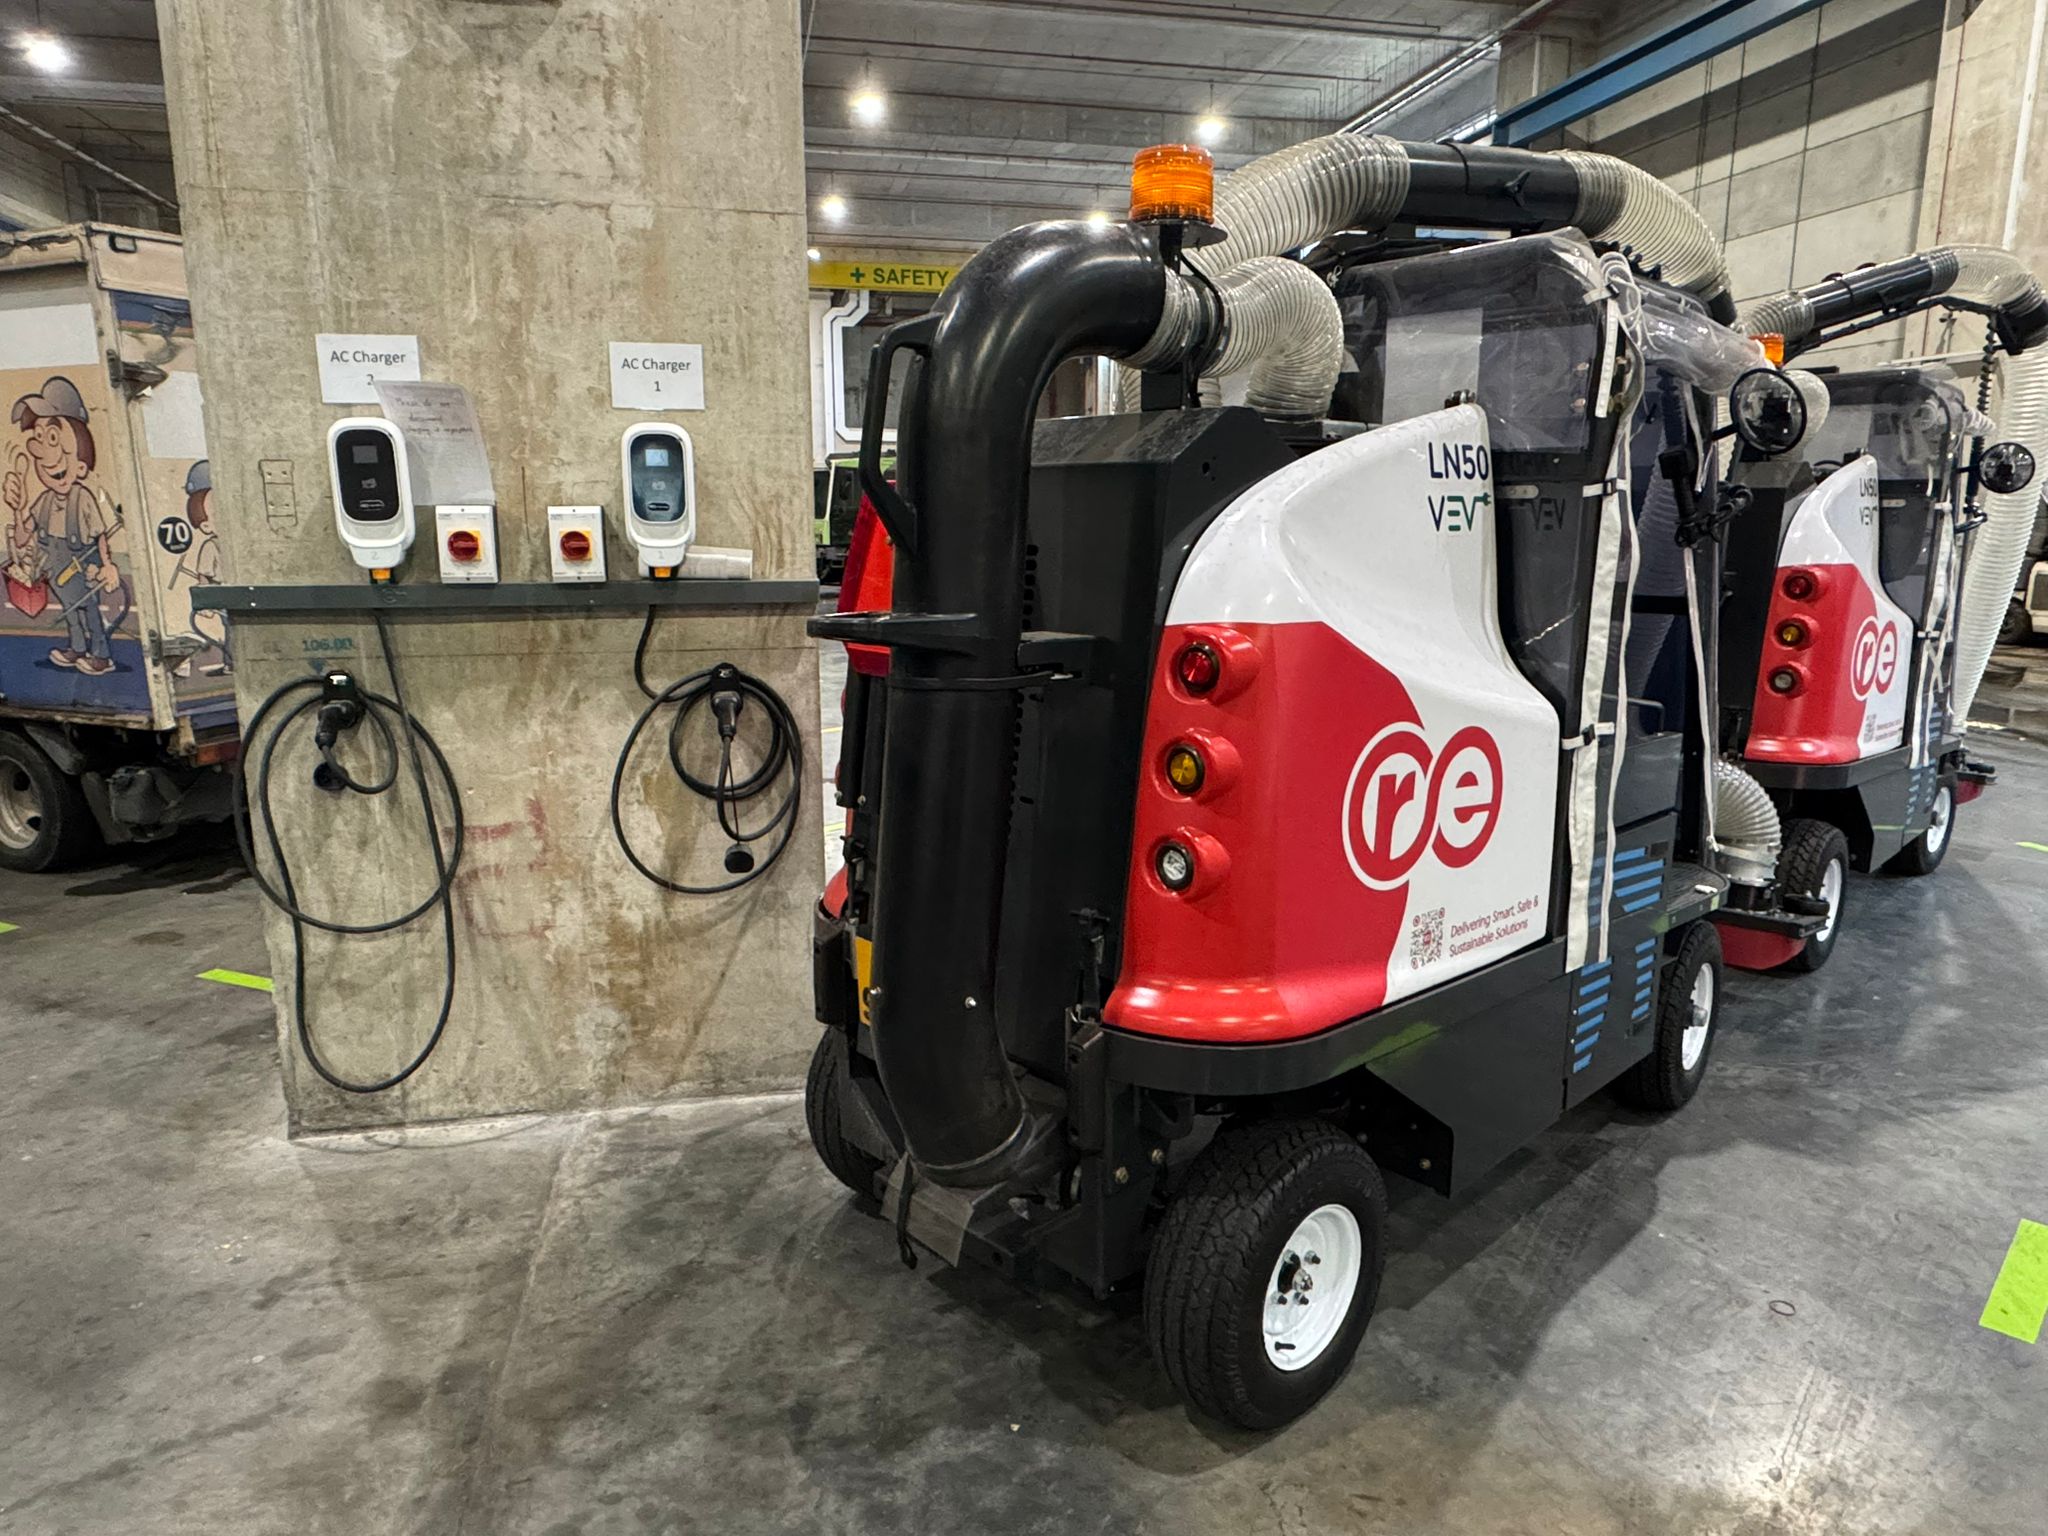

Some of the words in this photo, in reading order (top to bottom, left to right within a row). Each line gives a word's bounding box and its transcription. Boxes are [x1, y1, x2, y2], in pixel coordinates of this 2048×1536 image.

[873, 268, 949, 286] SAFETY
[330, 351, 349, 363] AC
[353, 351, 406, 366] Charger
[621, 358, 639, 370] AC
[642, 358, 691, 373] Charger
[366, 374, 374, 386] 2
[654, 381, 661, 392] 1
[1429, 442, 1489, 480] LN50
[160, 522, 190, 544] 70
[1347, 725, 1503, 882] re
[1451, 914, 1491, 938] Delivering
[1517, 898, 1533, 914] Safe
[1449, 931, 1495, 957] Sustainable
[1495, 919, 1528, 940] Solutions
